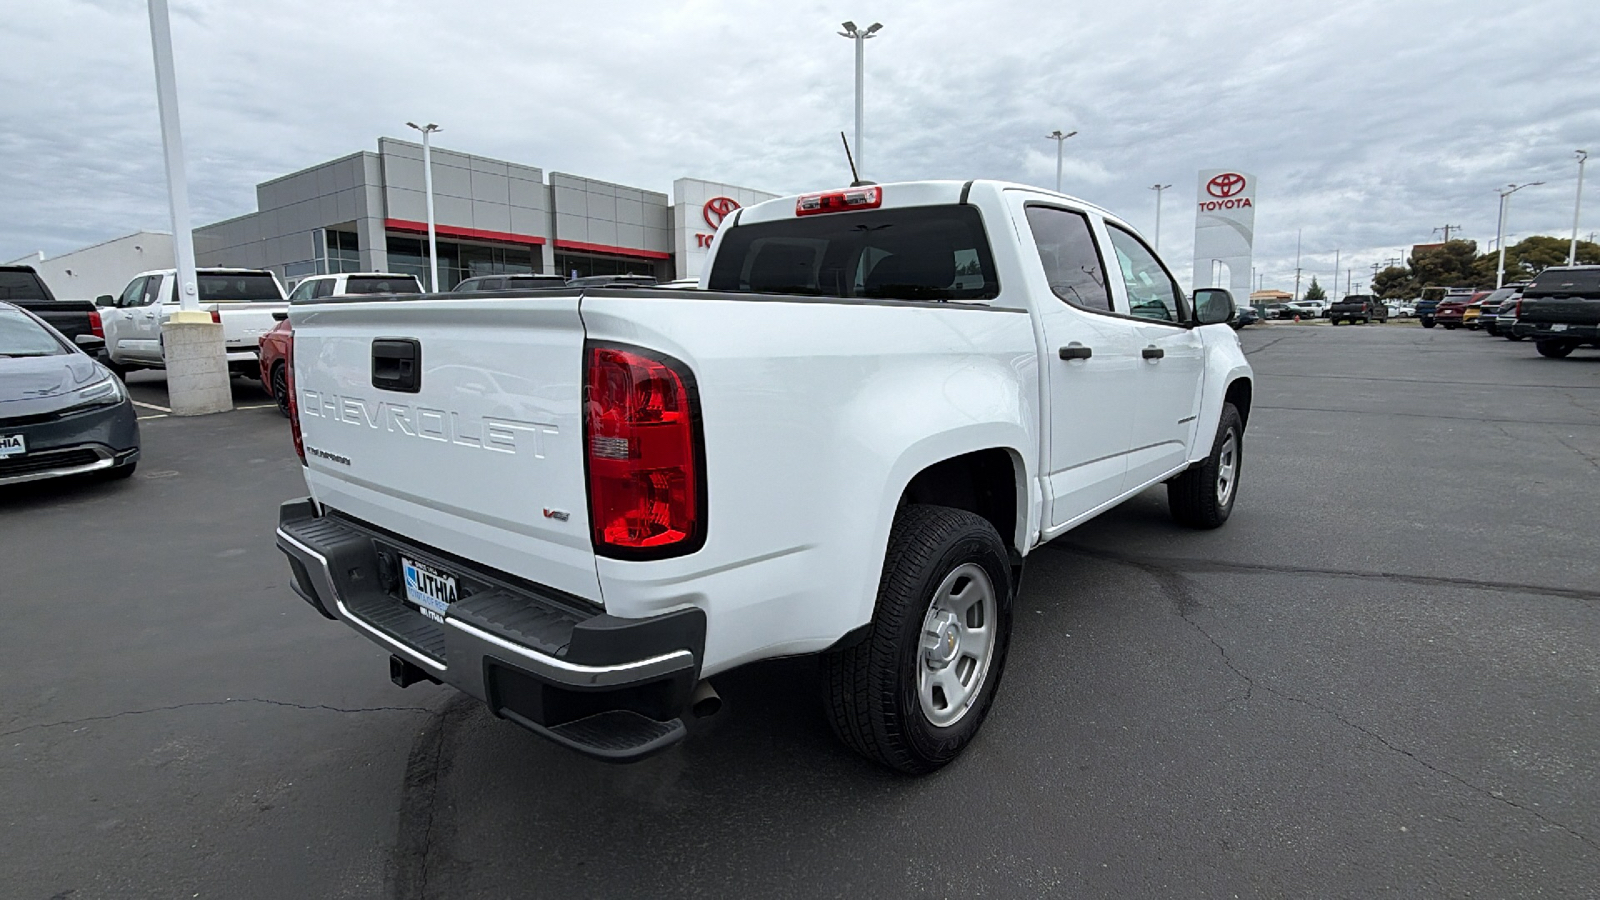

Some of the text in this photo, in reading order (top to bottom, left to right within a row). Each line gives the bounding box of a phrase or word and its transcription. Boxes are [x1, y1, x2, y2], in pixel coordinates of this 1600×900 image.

[1199, 198, 1252, 212] TOYOTA
[302, 389, 559, 459] CHEVROLET
[0, 438, 21, 449] HIA
[416, 569, 458, 605] LITHIA
